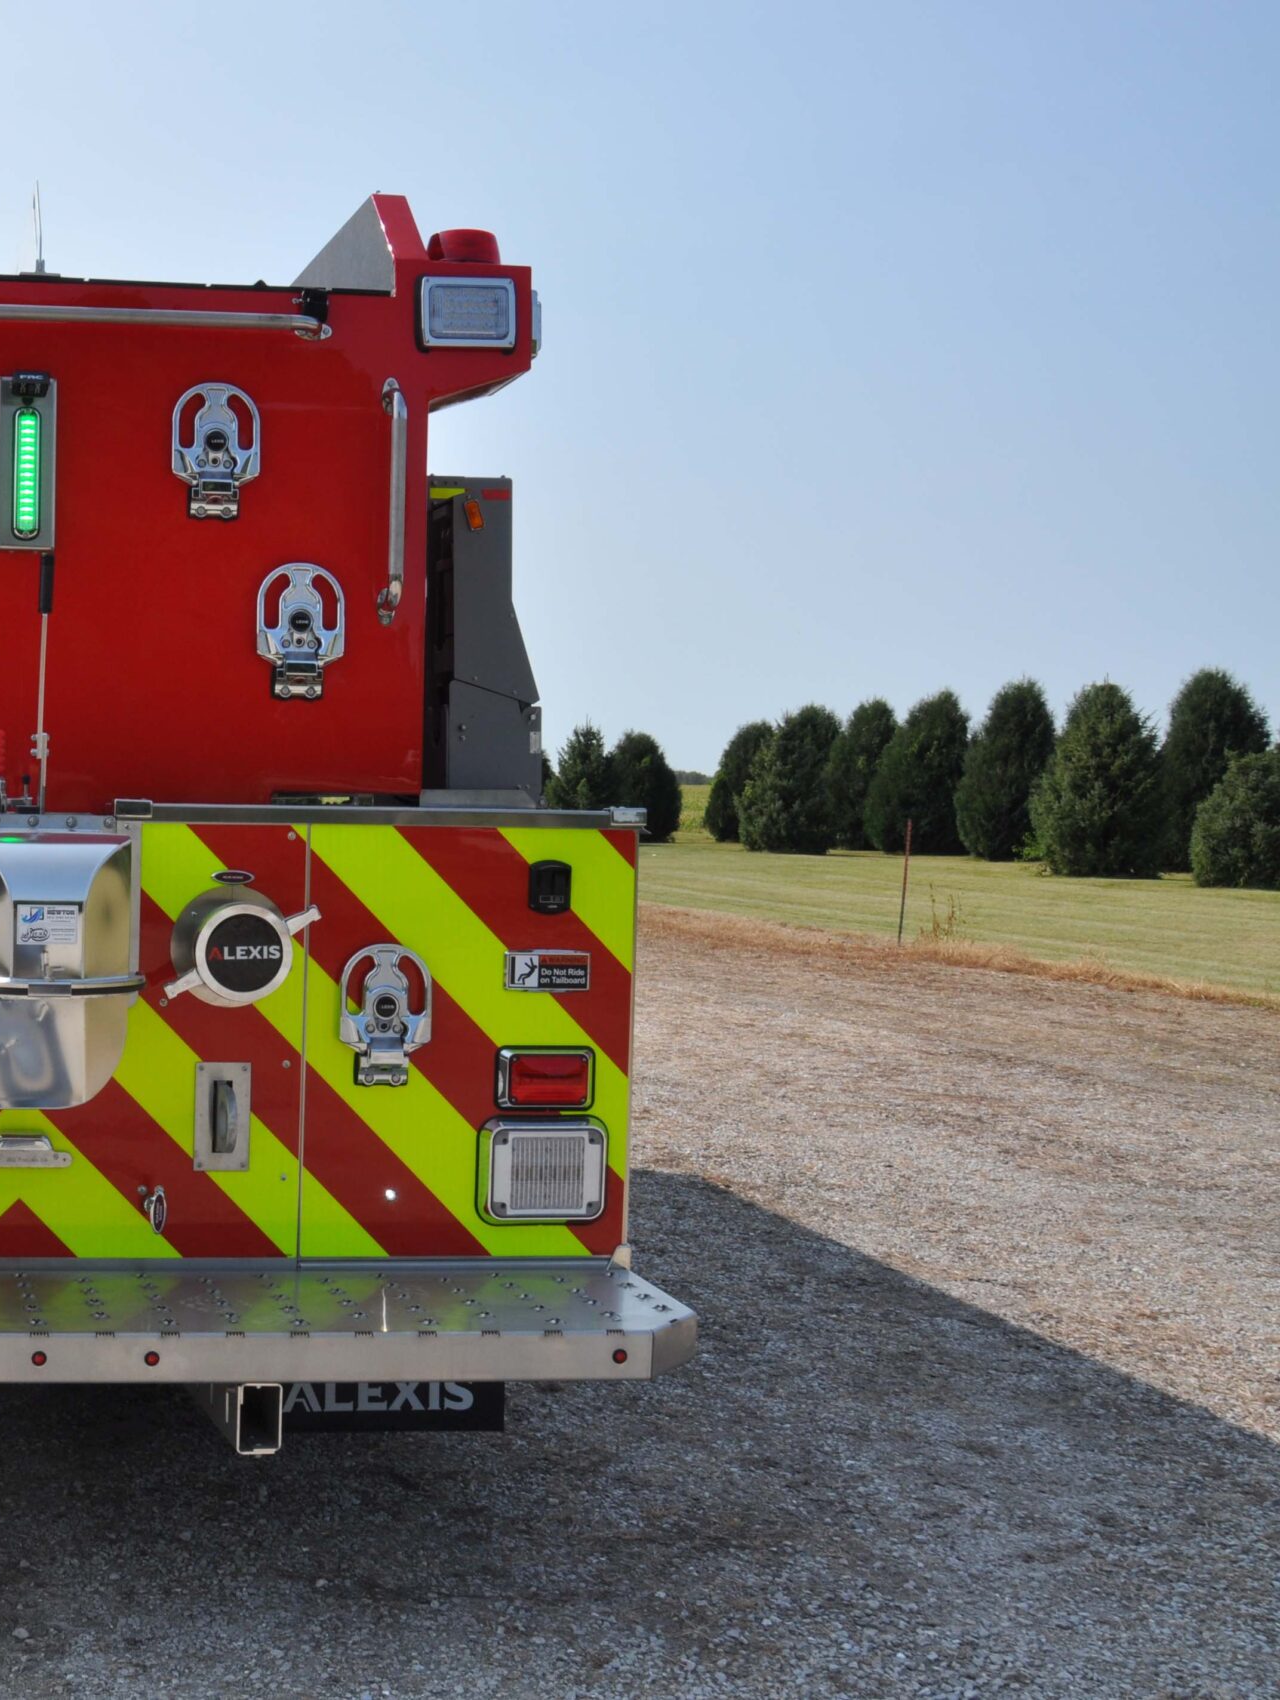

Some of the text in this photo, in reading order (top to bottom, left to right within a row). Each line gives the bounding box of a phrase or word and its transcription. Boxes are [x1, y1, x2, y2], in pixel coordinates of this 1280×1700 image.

[208, 945, 281, 961] ALEXIS
[541, 968, 585, 976] Do Not Ride
[540, 976, 586, 985] on Tailboard
[281, 1382, 475, 1412] ALEXIS
